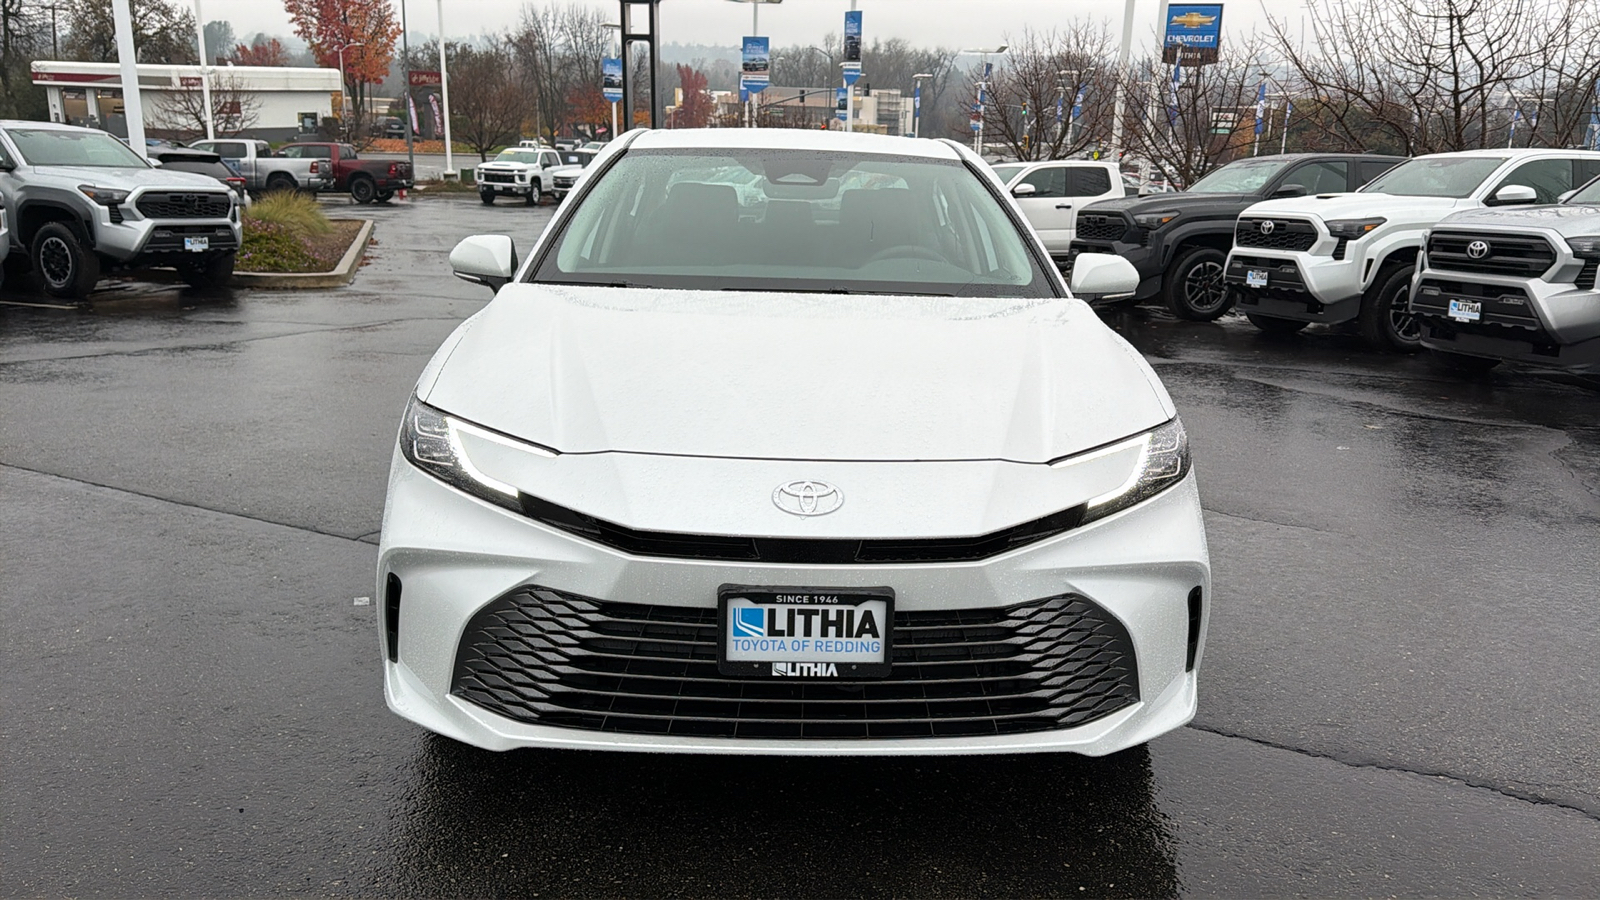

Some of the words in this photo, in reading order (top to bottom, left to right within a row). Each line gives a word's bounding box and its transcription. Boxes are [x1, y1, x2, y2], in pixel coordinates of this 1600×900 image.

[1457, 303, 1480, 313] LITHIA
[776, 595, 809, 604] SINCE
[814, 596, 838, 604] 1946
[768, 608, 880, 638] LITHIA
[732, 639, 787, 652] TOYOTA
[791, 640, 810, 653] OF
[814, 641, 881, 653] REDDING
[786, 662, 839, 677] LITHIA
